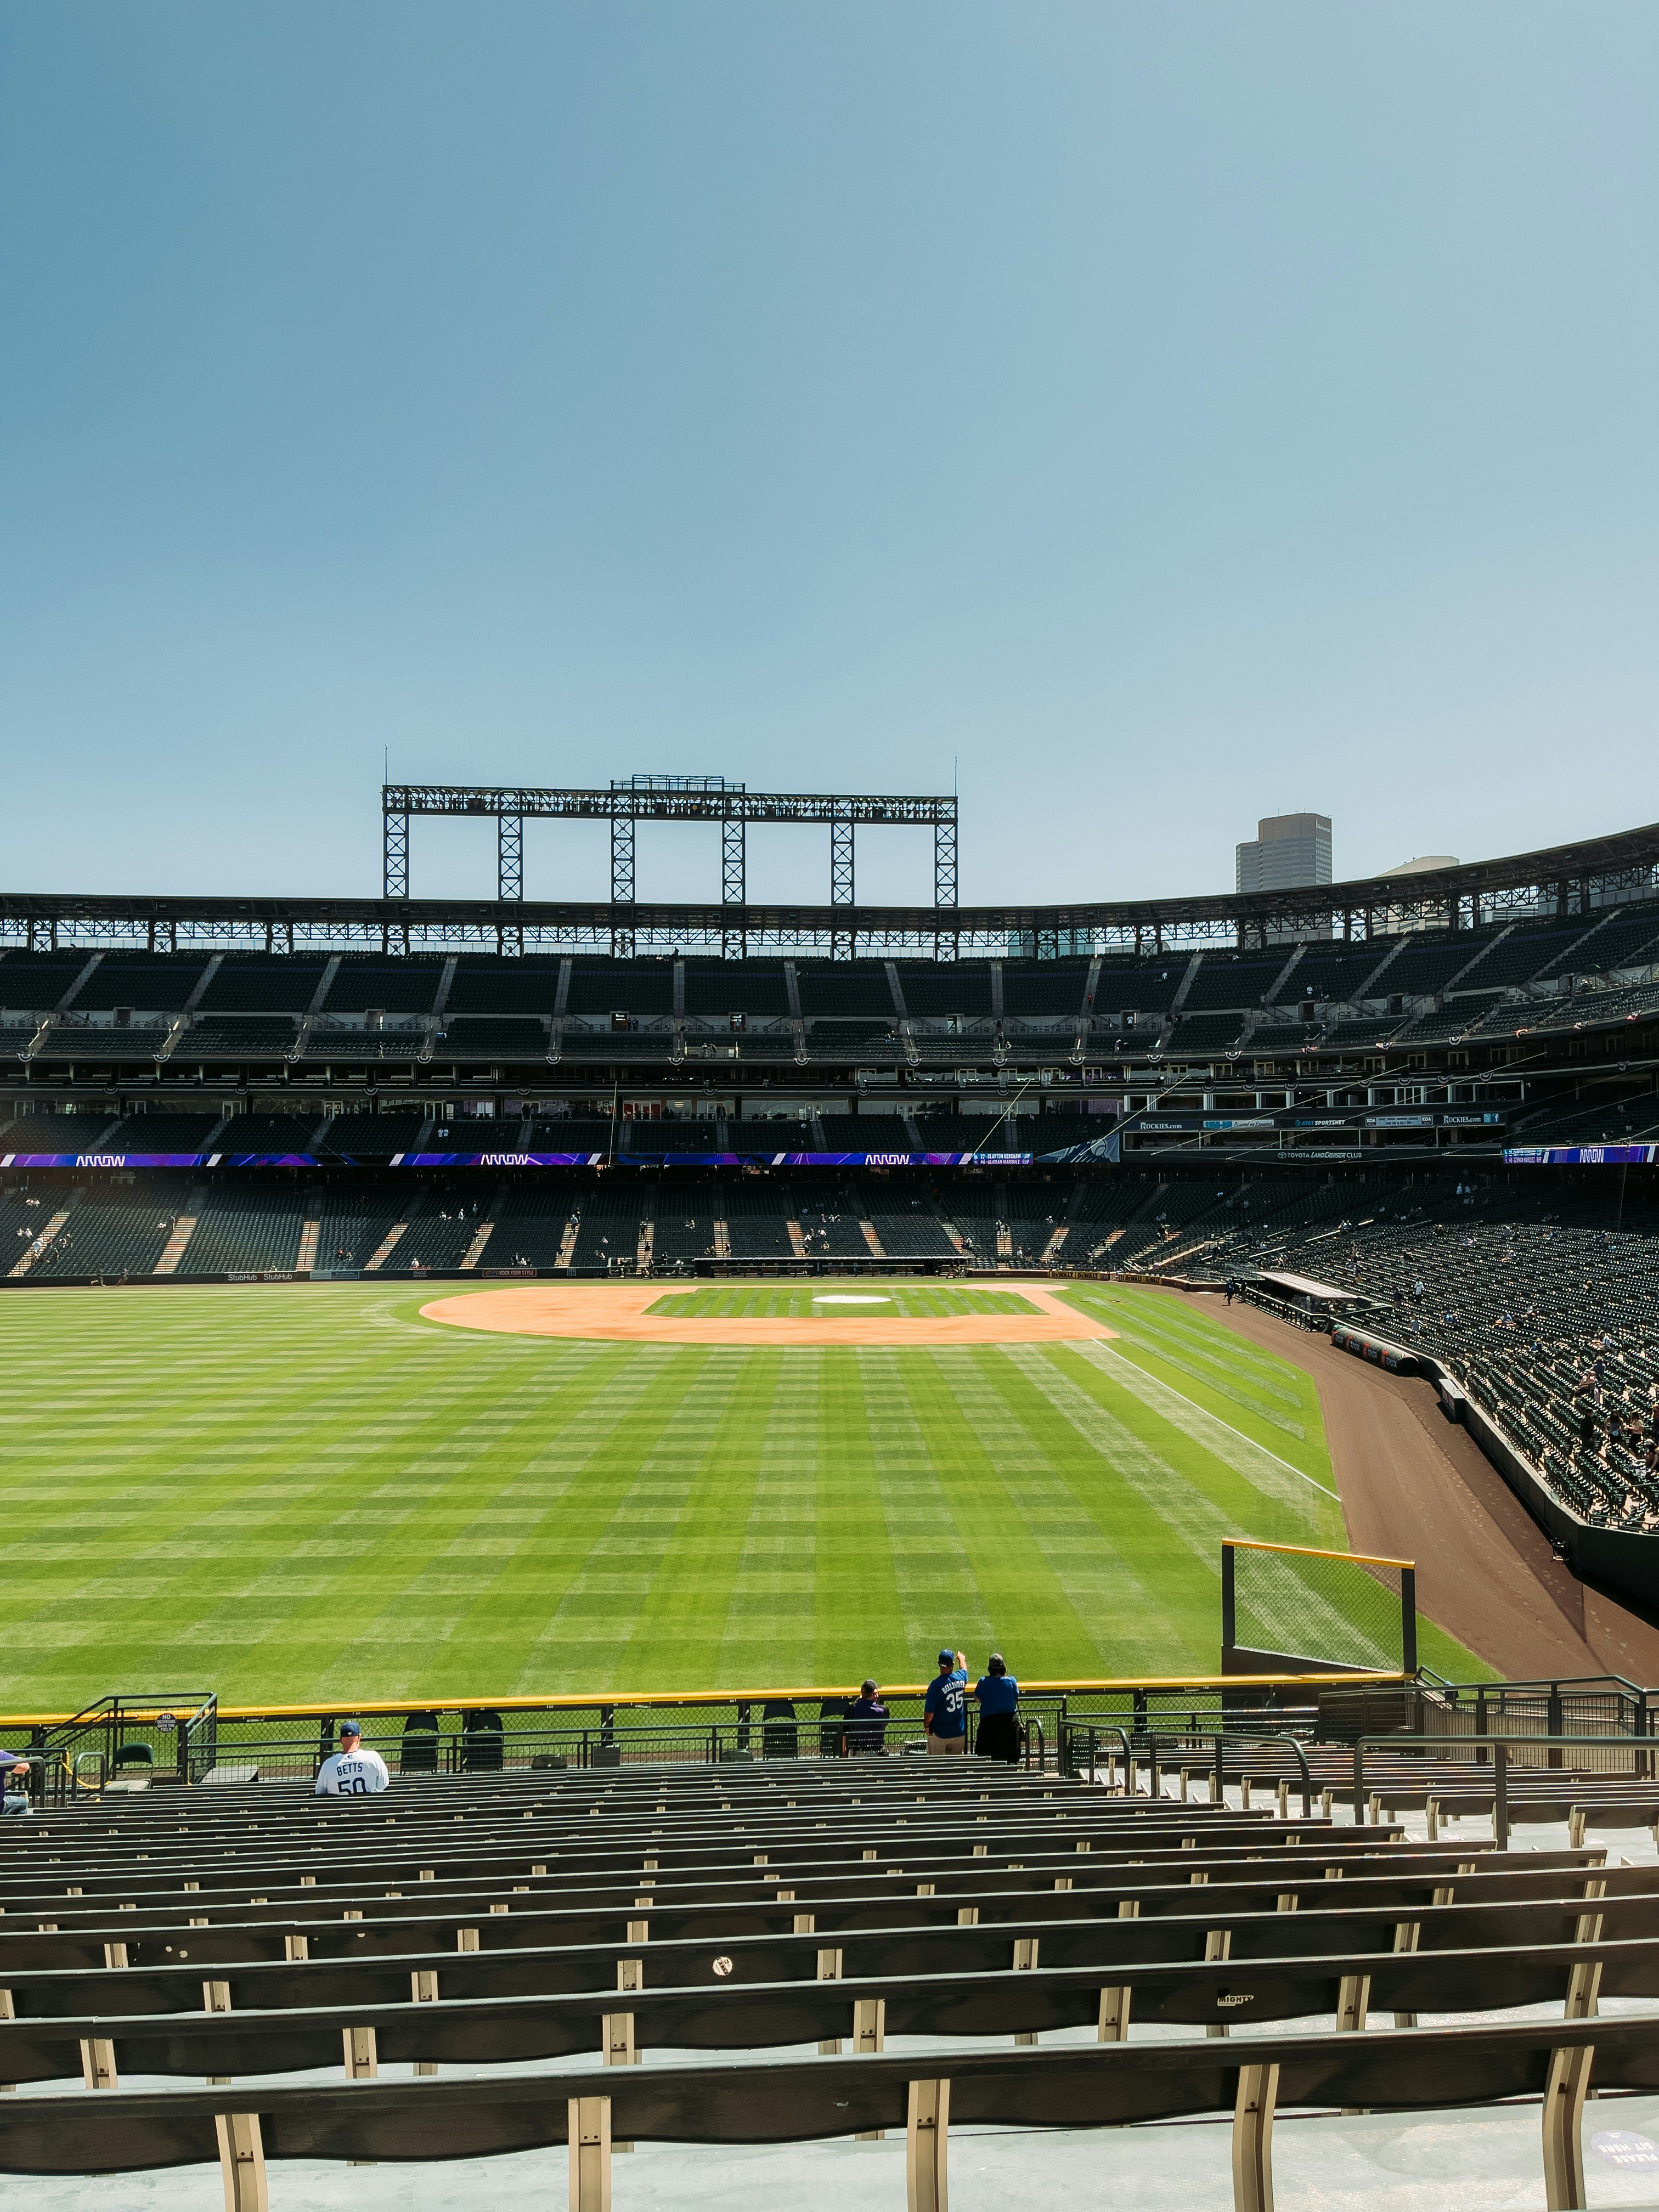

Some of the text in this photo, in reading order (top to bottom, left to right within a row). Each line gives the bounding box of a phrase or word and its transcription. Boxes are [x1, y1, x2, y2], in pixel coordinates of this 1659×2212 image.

[1443, 1115, 1481, 1124] ROCKIES.com
[76, 1155, 126, 1166] ARROW
[481, 1154, 528, 1165] ARROW
[865, 1154, 910, 1165] ARROW
[946, 1690, 964, 1712] 35
[336, 1762, 363, 1776] BETTS
[337, 1776, 367, 1795] 50
[1598, 2142, 1654, 2153] SIT HERE
[1612, 2153, 1658, 2163] PLEASE
